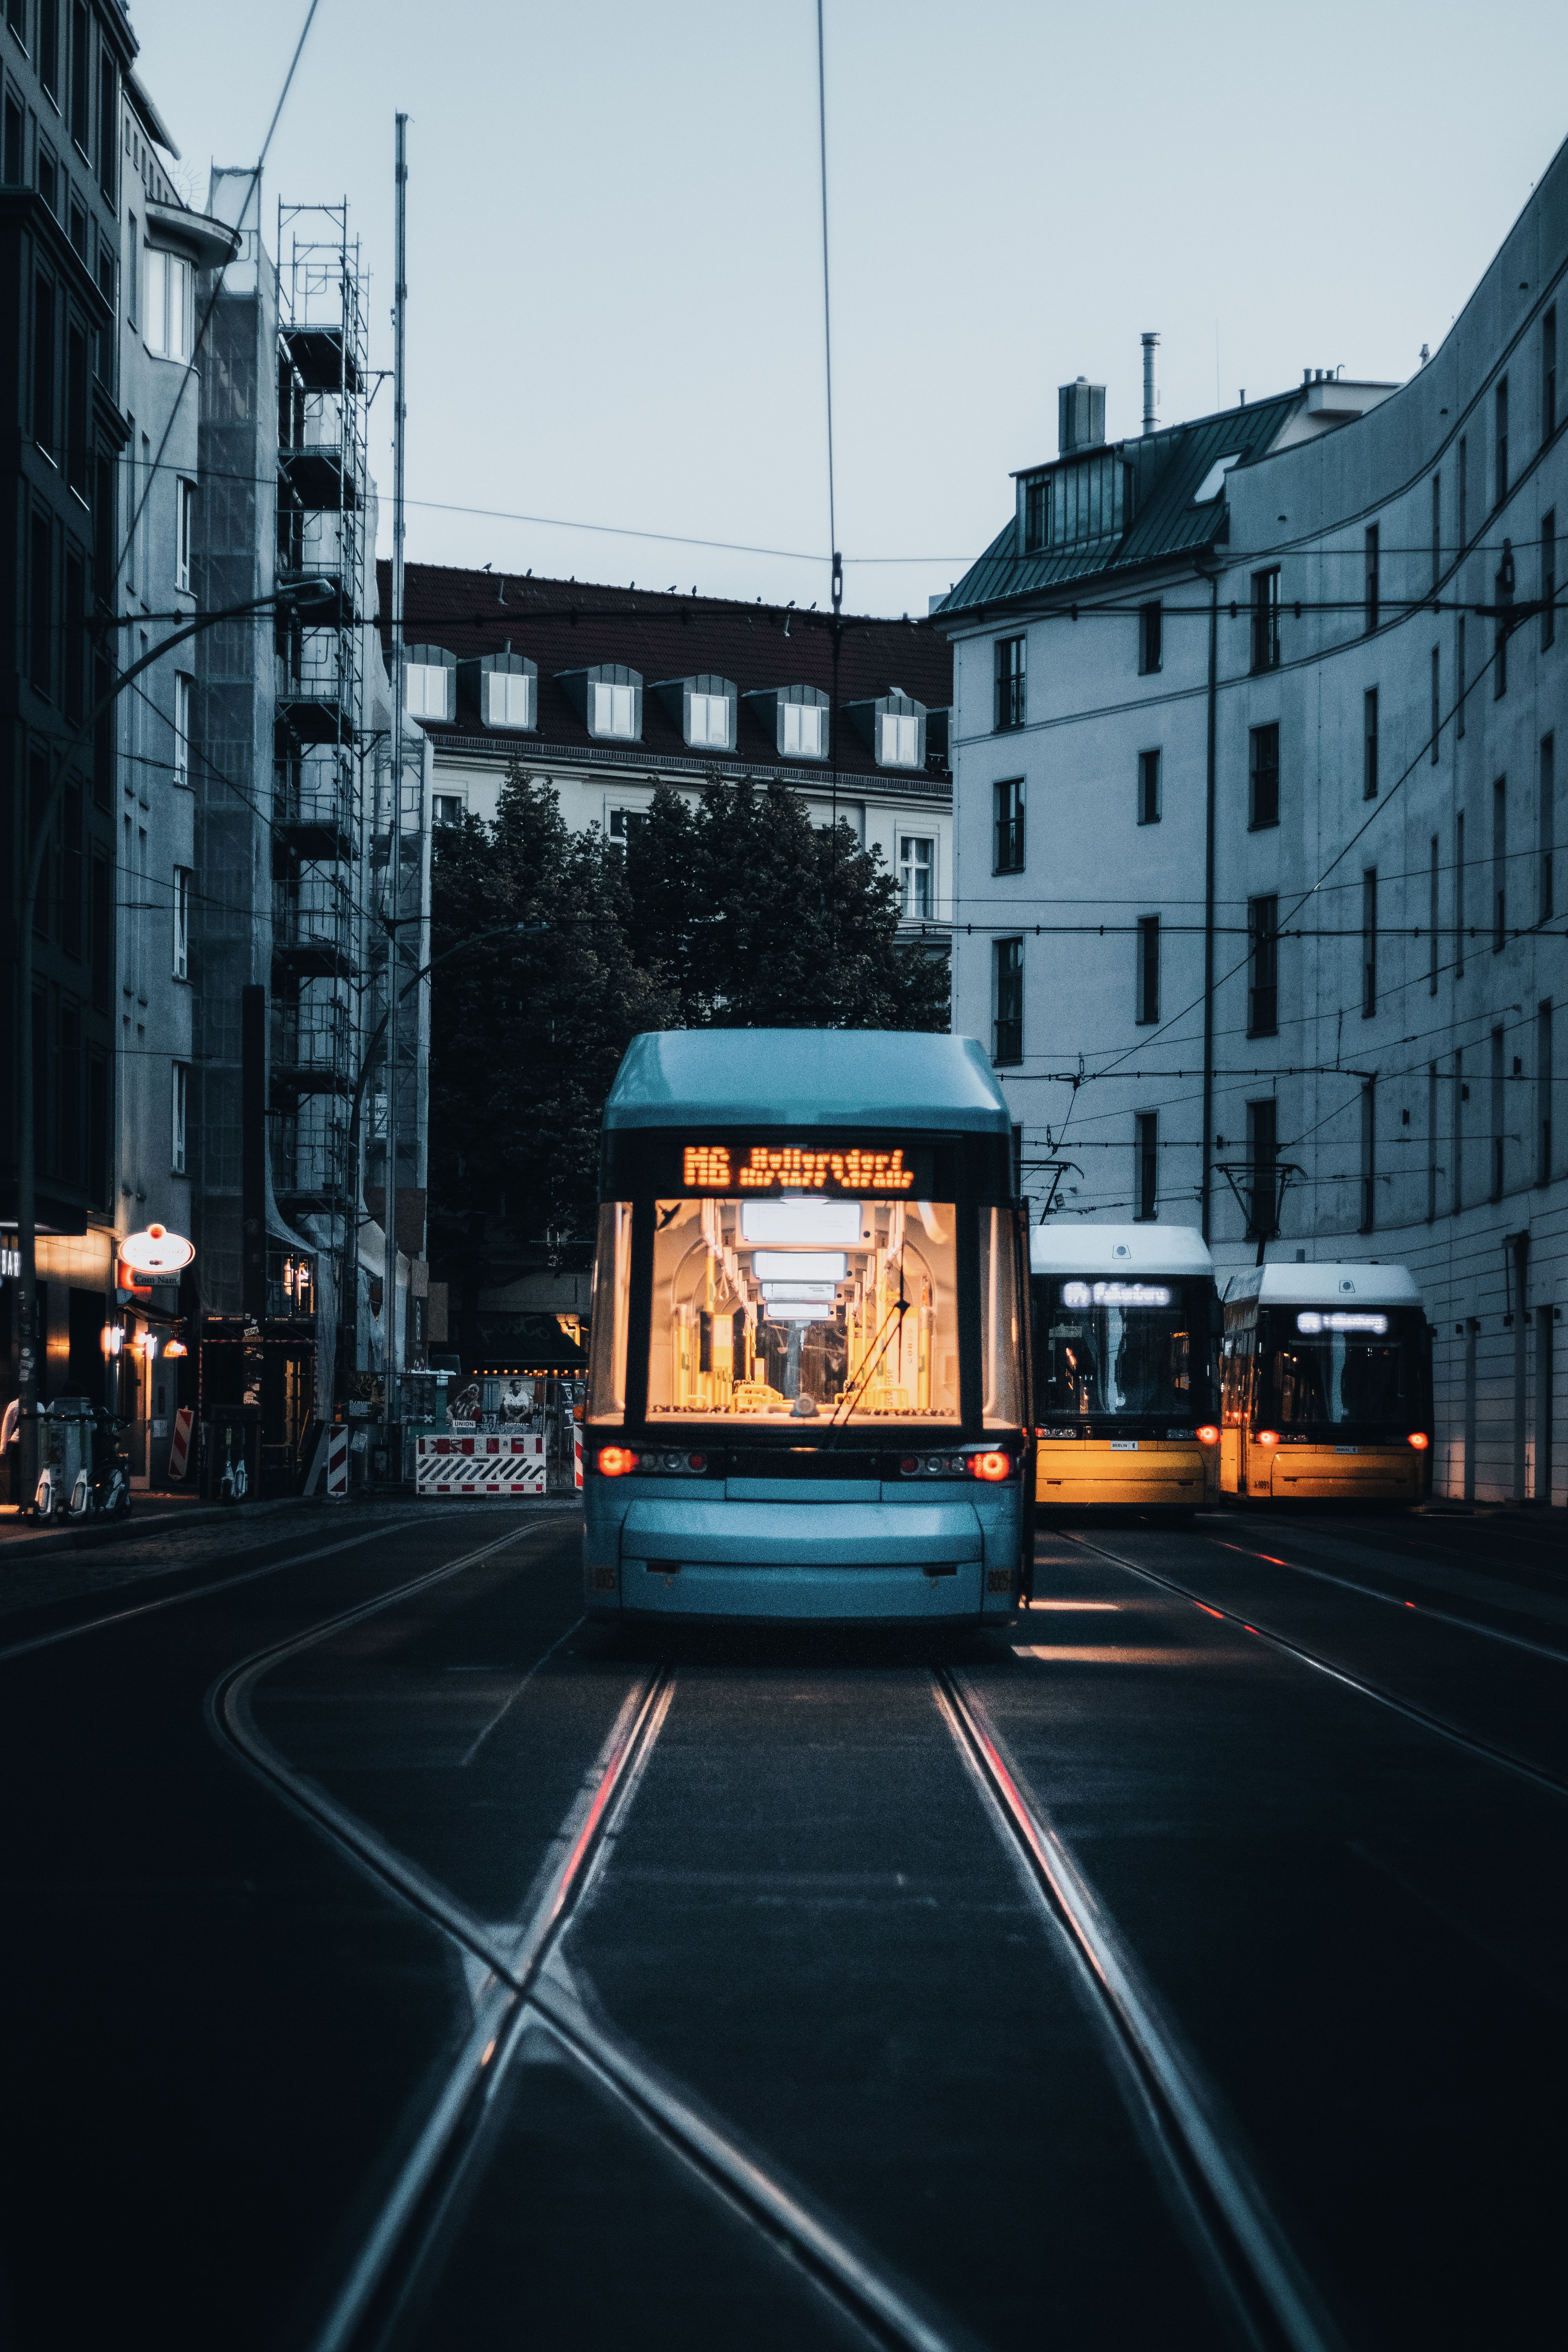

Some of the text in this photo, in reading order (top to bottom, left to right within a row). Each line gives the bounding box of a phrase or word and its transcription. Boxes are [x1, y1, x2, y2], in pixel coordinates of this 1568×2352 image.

[686, 1148, 730, 1185] M6
[2, 1249, 18, 1277] BAR
[158, 1276, 177, 1285] Nam
